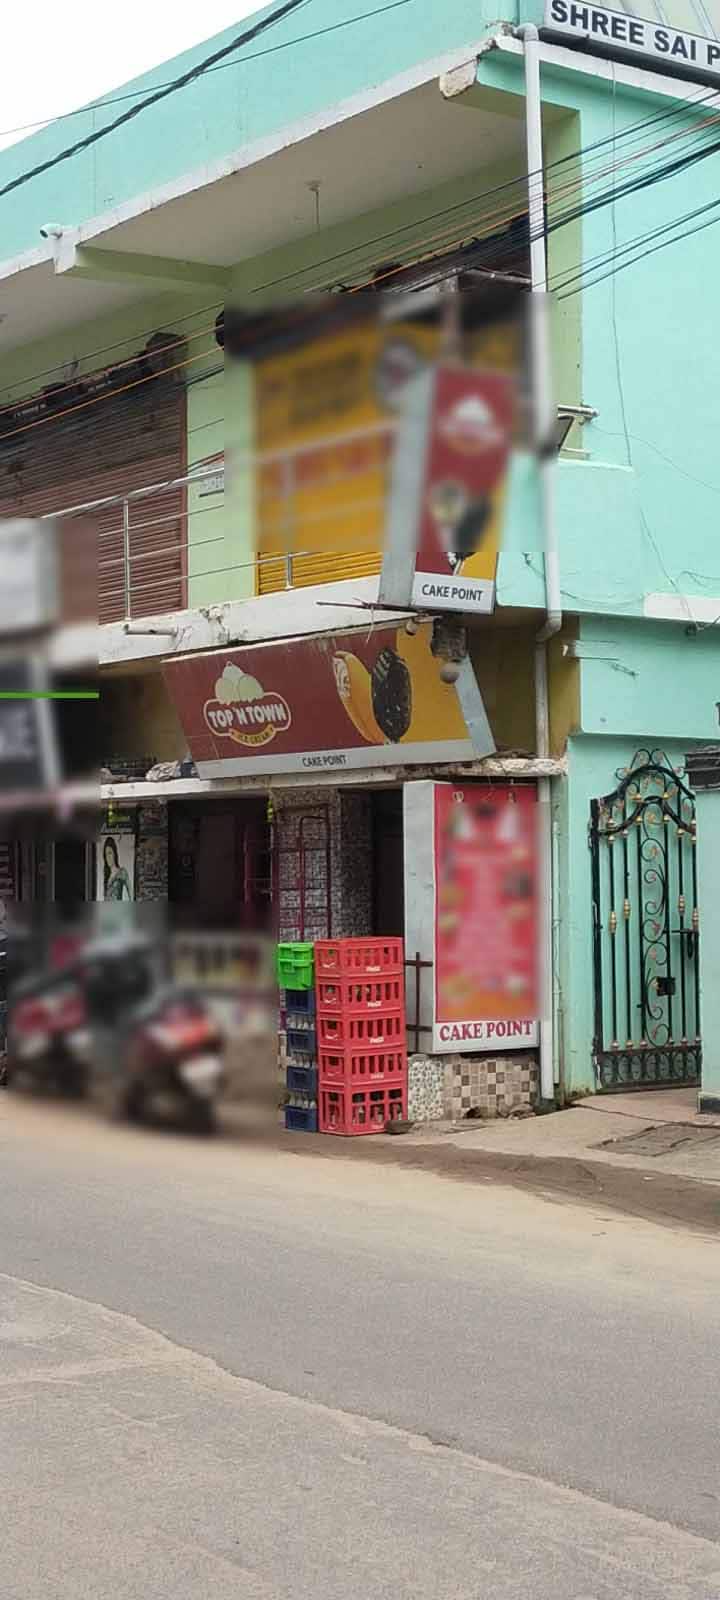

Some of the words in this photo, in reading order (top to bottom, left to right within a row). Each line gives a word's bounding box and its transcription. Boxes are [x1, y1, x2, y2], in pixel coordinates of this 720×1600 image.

[551, 0, 645, 46] SHREE
[654, 30, 697, 61] SAI
[422, 584, 449, 597] CAKE
[451, 587, 483, 601] POINT
[208, 710, 234, 728] TOP
[246, 703, 286, 724] TOWN
[302, 756, 322, 768] CAKE
[322, 754, 347, 766] POINT
[439, 1023, 482, 1041] CAKE
[487, 1020, 533, 1039] POINT
